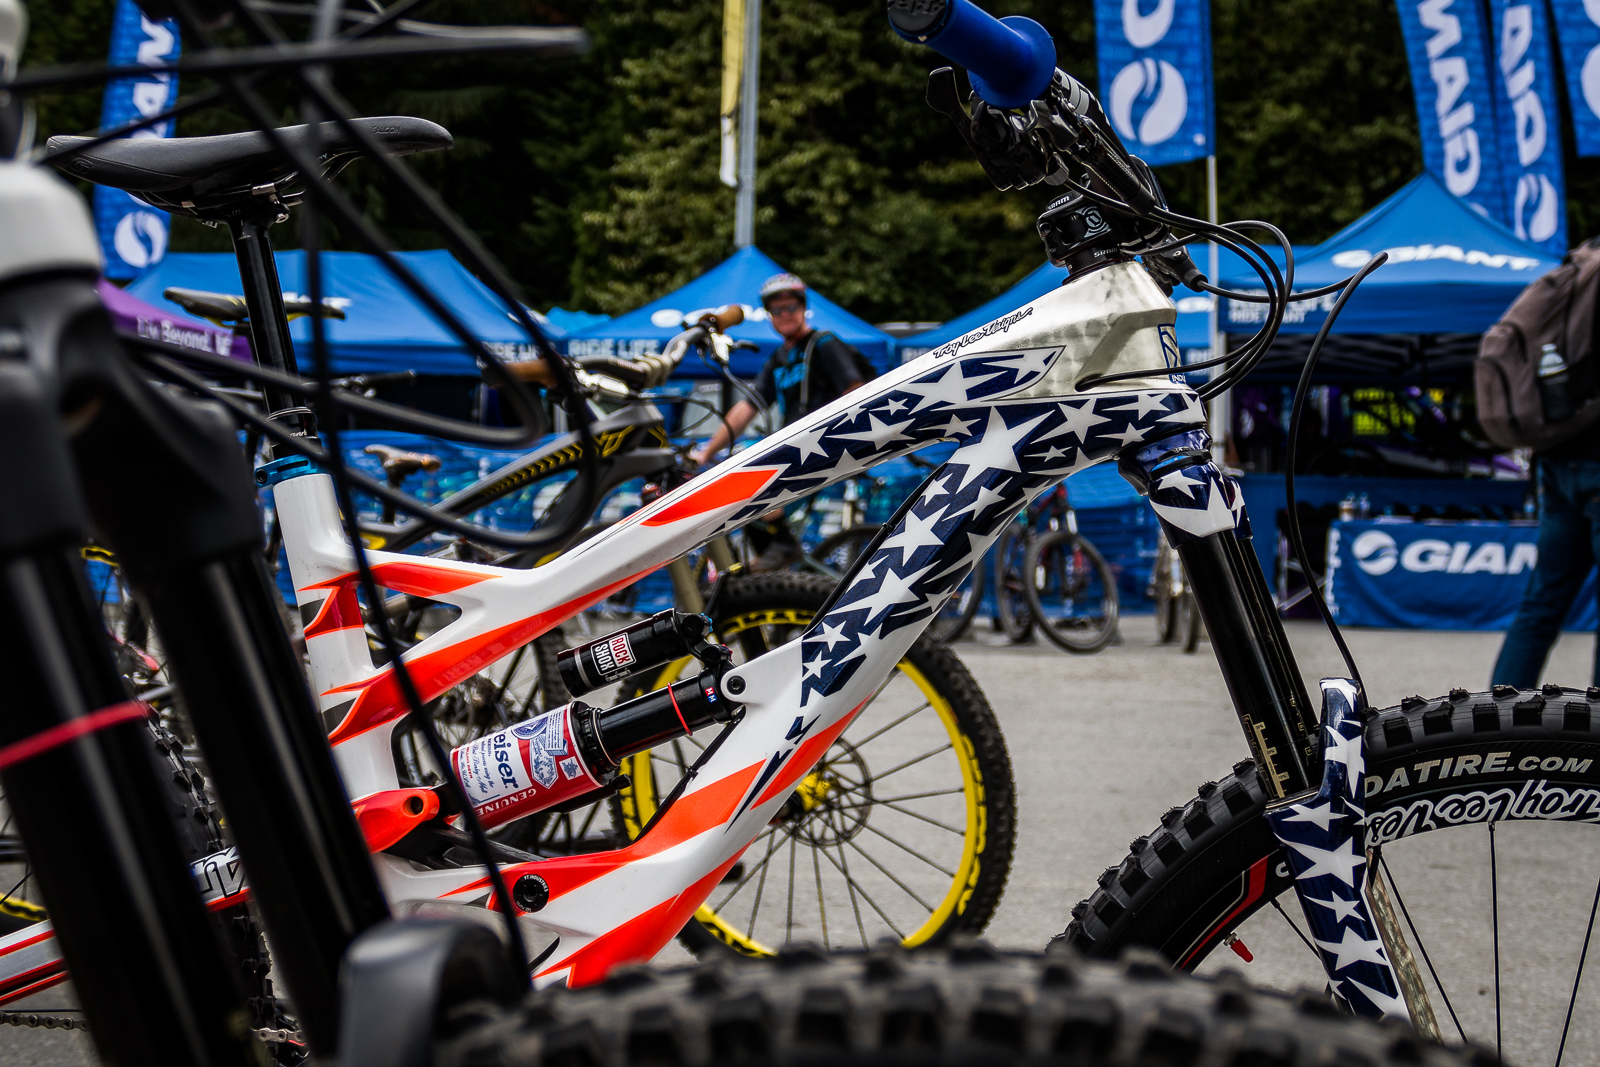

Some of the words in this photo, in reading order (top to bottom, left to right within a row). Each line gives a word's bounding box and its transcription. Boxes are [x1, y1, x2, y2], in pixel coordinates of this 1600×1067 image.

[933, 341, 960, 359] Troy
[960, 332, 985, 347] Lee
[983, 307, 1034, 336] Designs
[1401, 539, 1538, 574] GIAN
[594, 643, 615, 671] SHOX
[611, 637, 631, 665] ROCK
[493, 732, 519, 789] eiser.
[1364, 751, 1594, 798] DATIRE.COM
[475, 788, 537, 817] GENUINE
[1434, 788, 1516, 823] Lee
